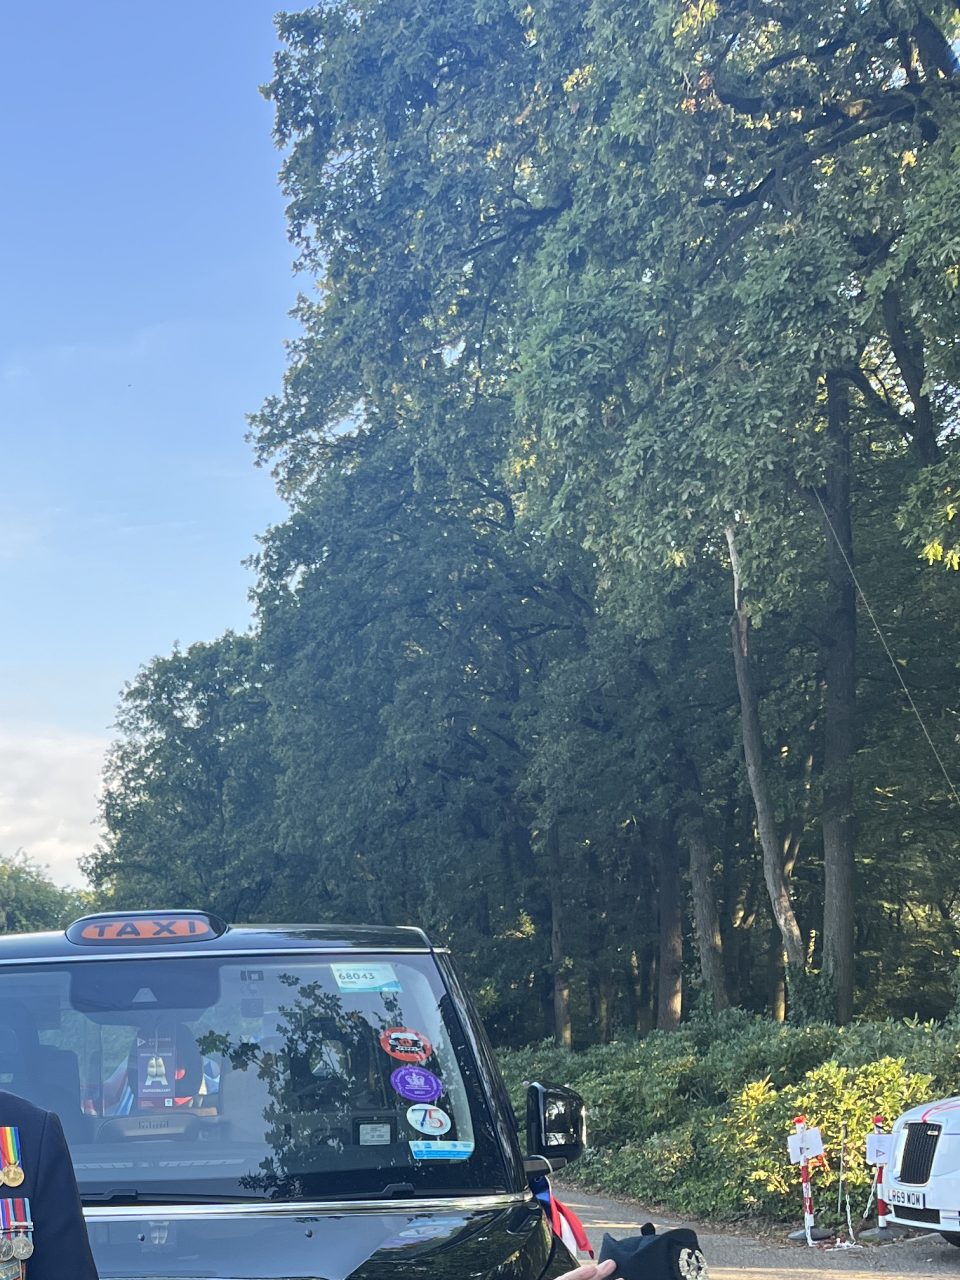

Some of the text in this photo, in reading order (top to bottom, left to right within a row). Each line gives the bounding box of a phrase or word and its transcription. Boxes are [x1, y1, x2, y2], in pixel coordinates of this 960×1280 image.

[94, 921, 196, 938] TAXI
[338, 972, 375, 981] 68043
[411, 1108, 444, 1129] 75
